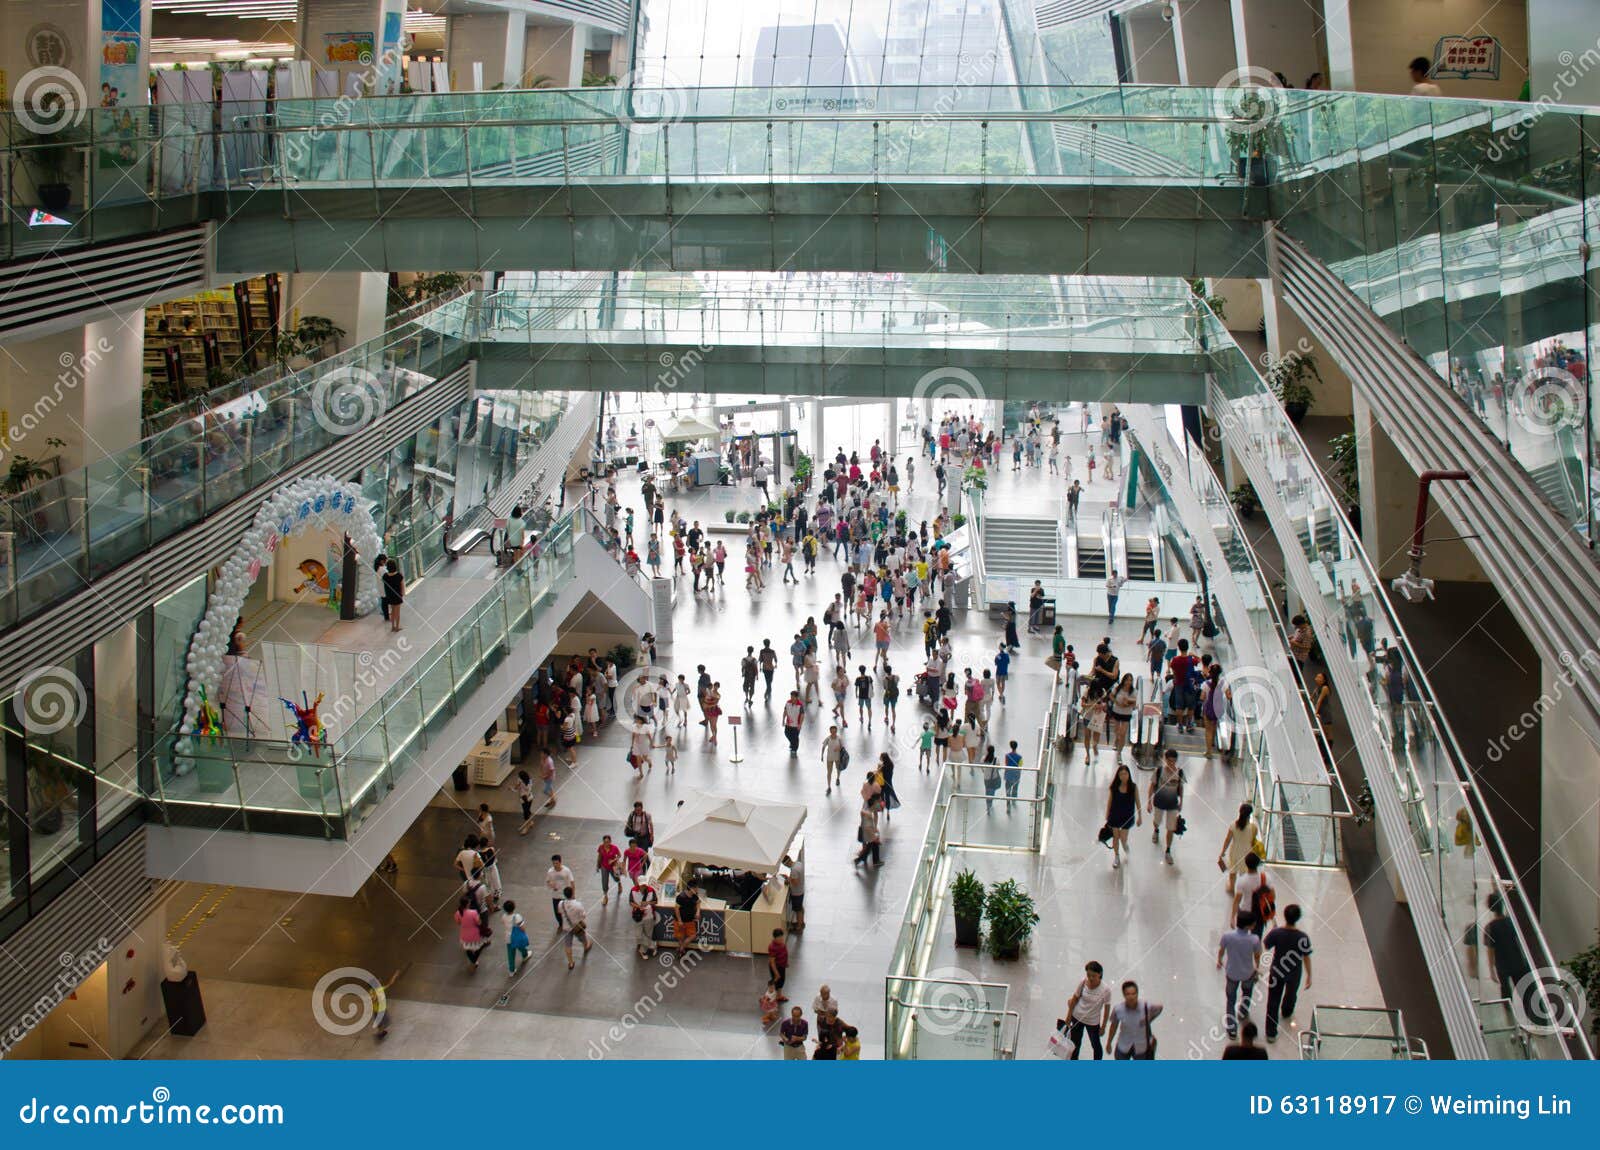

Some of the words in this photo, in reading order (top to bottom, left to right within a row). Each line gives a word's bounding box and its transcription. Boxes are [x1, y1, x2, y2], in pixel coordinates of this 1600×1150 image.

[1447, 56, 1486, 64] 保持安静
[663, 914, 719, 936] 咨处
